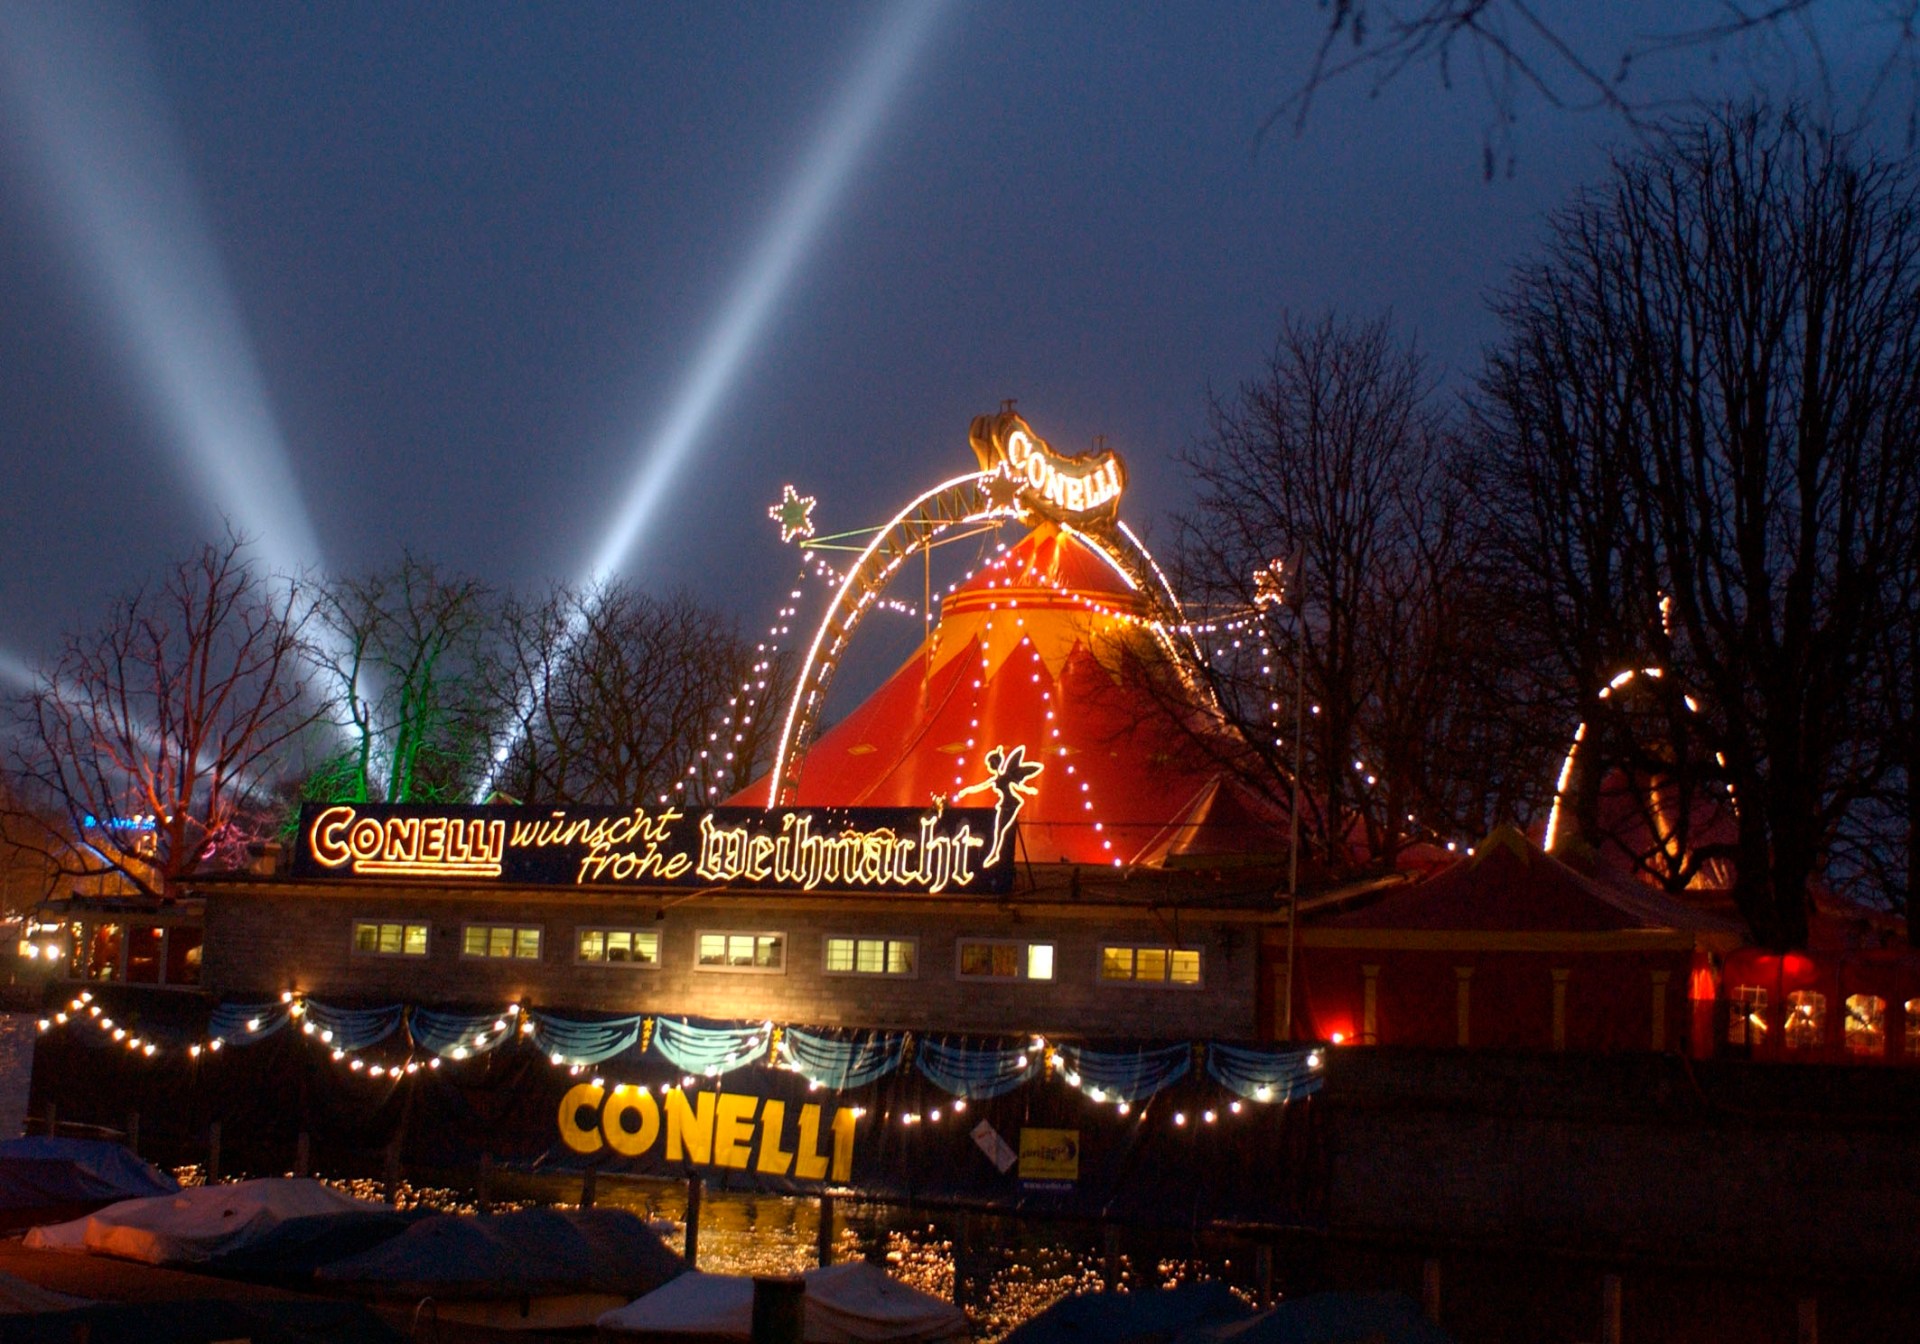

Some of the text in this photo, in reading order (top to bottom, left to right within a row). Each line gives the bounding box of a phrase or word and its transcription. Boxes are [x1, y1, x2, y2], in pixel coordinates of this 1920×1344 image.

[1008, 431, 1122, 512] CONELLI
[310, 806, 505, 867] CONELLI
[577, 841, 693, 885] frohe
[558, 1083, 858, 1182] CONELLI
